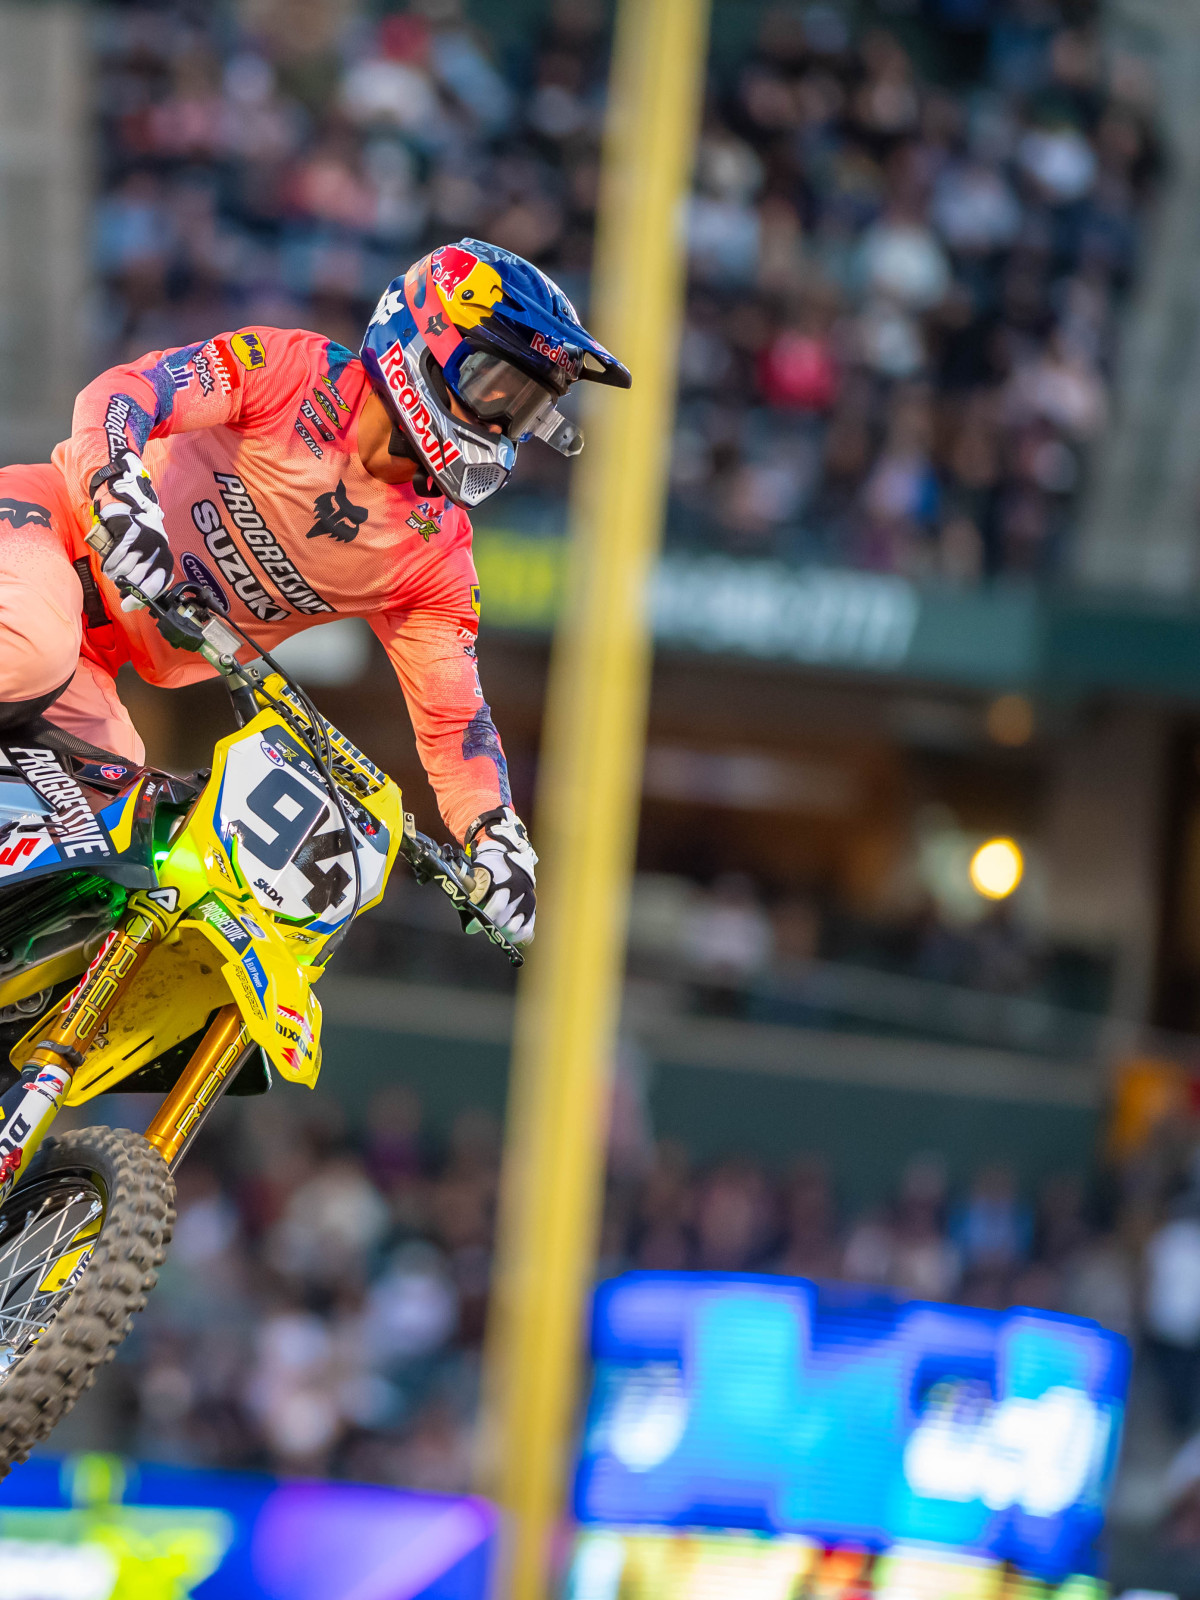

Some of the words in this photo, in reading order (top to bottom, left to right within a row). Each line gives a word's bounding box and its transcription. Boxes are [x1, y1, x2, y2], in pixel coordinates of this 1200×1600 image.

[531, 332, 559, 364] Red
[378, 339, 421, 412] Red
[409, 403, 462, 474] Bull
[191, 499, 292, 622] SUZUKI
[213, 471, 338, 616] PROGRESSIVE
[8, 747, 111, 859] PROGRESSIVE
[231, 768, 364, 914] 94
[253, 878, 284, 908] SKDA
[75, 944, 139, 1040] REP
[275, 1021, 313, 1061] DIXXON
[175, 1043, 239, 1138] REP
